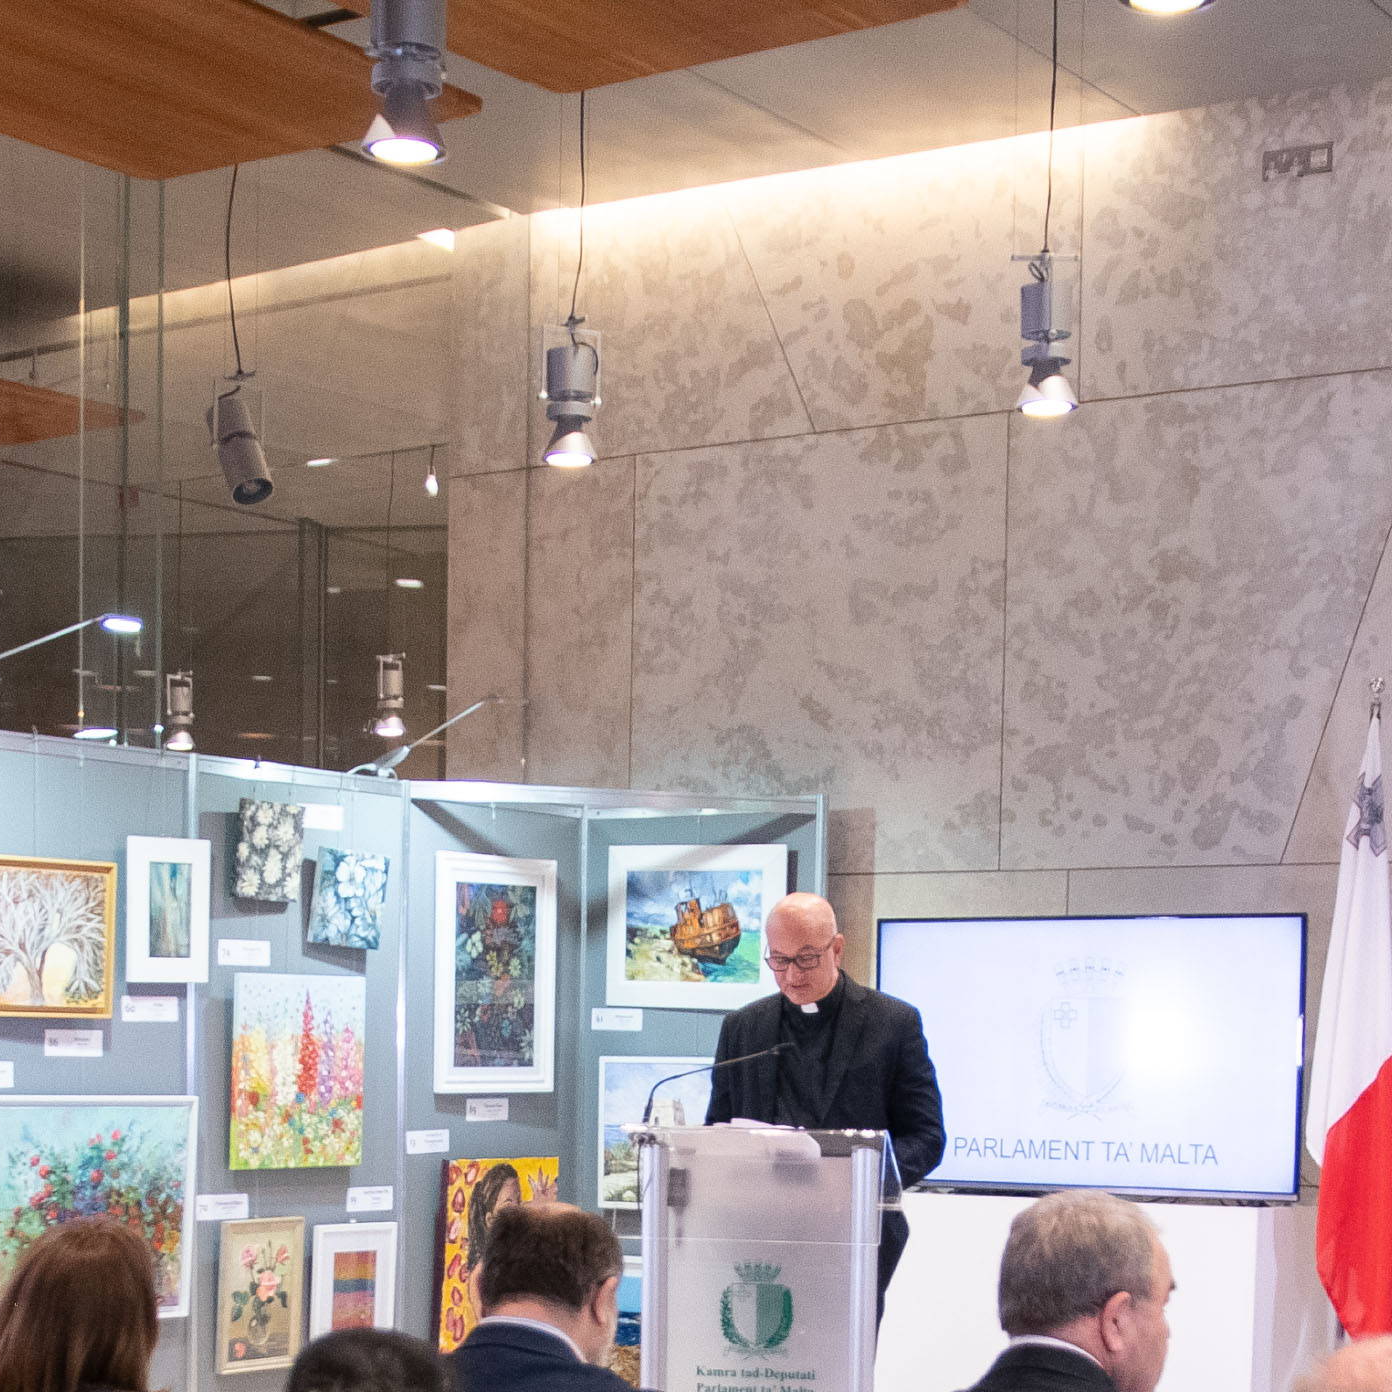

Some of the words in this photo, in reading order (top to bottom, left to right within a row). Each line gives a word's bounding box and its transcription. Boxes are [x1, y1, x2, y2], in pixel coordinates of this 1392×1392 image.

[953, 1136, 1095, 1161] PARLAMENT
[1101, 1141, 1134, 1163] TA'
[1140, 1143, 1219, 1165] MALTA
[696, 1365, 737, 1377] Kamra
[741, 1367, 816, 1381] tad-Deputati
